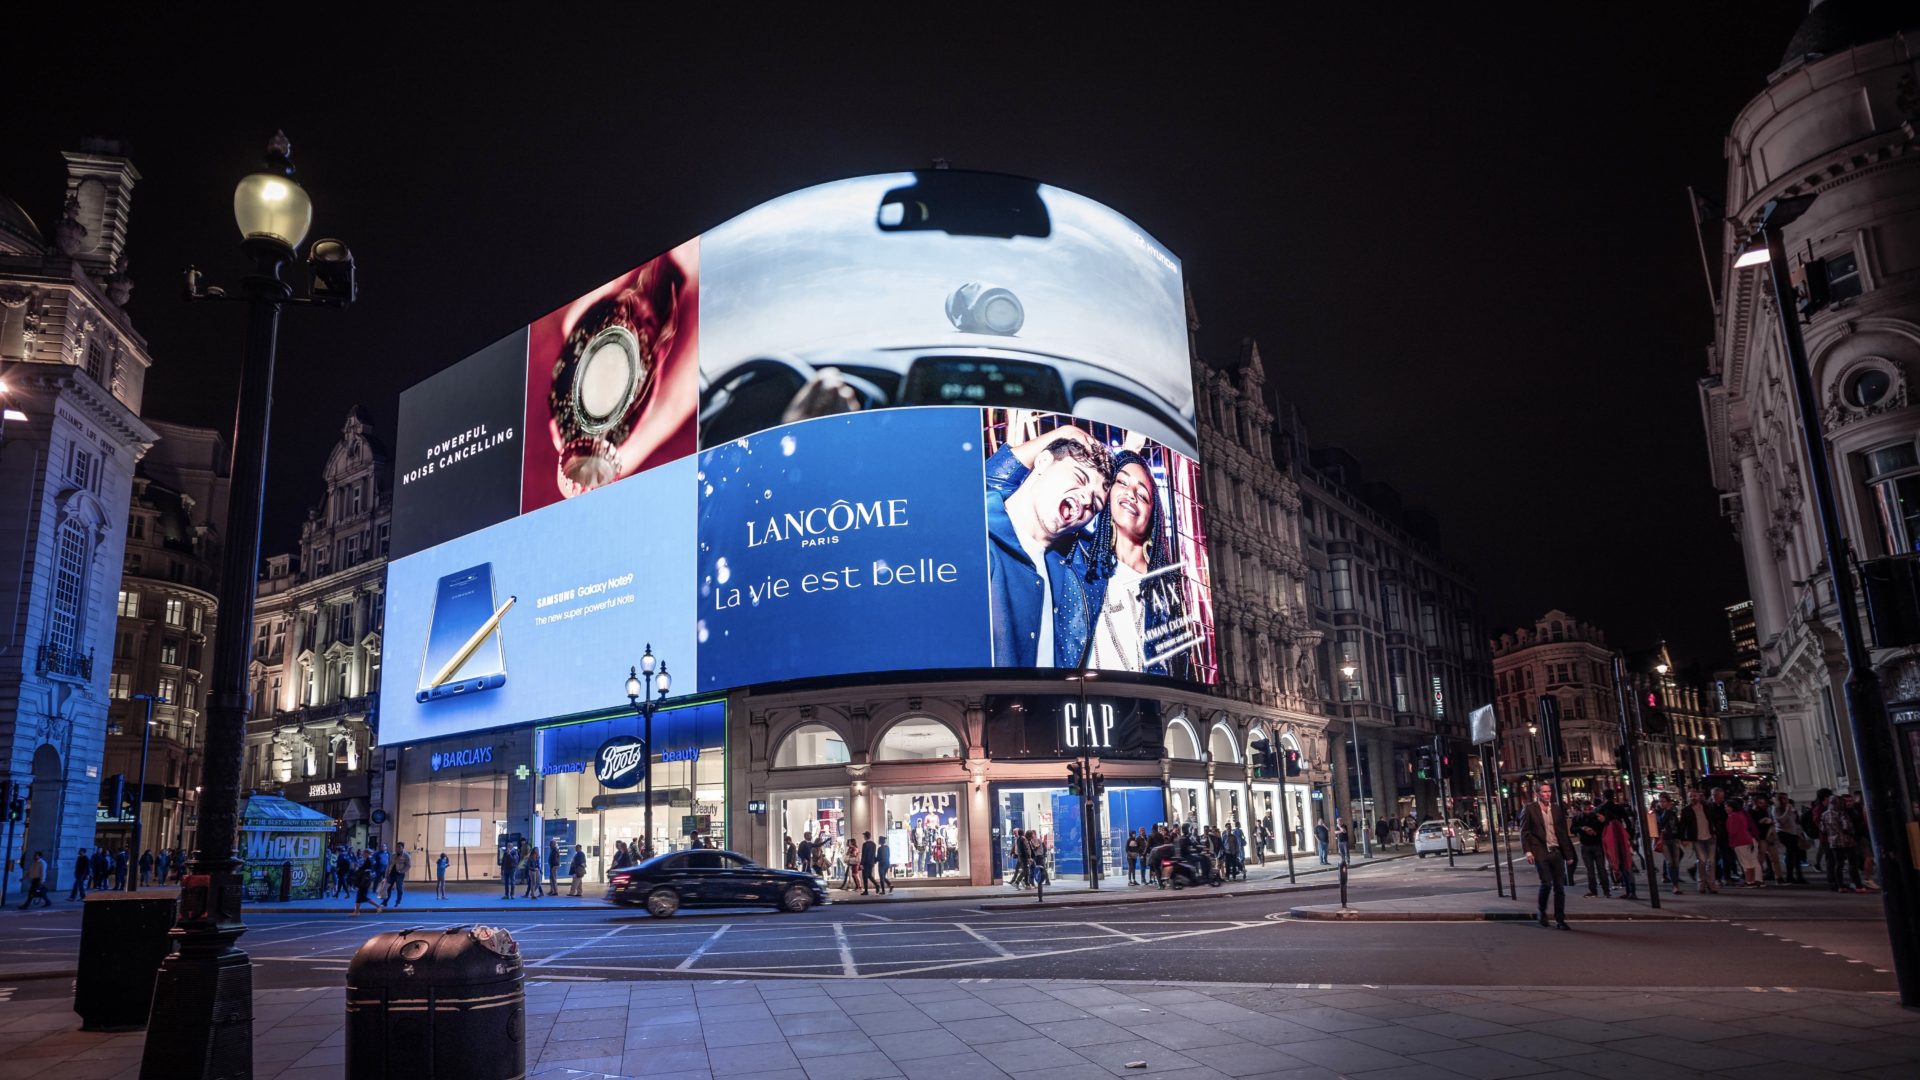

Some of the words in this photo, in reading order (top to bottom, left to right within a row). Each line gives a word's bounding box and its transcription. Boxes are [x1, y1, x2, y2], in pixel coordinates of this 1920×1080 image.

[59, 407, 83, 431] ALLIANCE
[86, 427, 97, 442] LIFE
[427, 424, 487, 459] POWERFUL
[403, 463, 434, 485] NOISE
[440, 428, 513, 469] CANCELLING
[746, 499, 909, 547] LANCÔME
[801, 535, 839, 548] PARIS
[537, 589, 575, 609] SAMSUNG
[577, 582, 607, 597] Galaxy
[608, 573, 634, 590] Note9
[715, 587, 741, 610] La
[750, 576, 790, 602] vie
[801, 566, 862, 593] est
[873, 558, 957, 586] belle
[535, 616, 548, 626] The
[548, 612, 563, 624] new
[563, 606, 584, 620] super
[584, 596, 616, 616] powerful
[616, 594, 635, 606] Note
[1064, 702, 1114, 748] GAP
[443, 746, 492, 768] BARCLAYS
[541, 760, 587, 778] pharmacy
[598, 743, 642, 780] Boots
[662, 746, 699, 763] beauty
[328, 782, 341, 796] BAR
[909, 792, 949, 815] GAP
